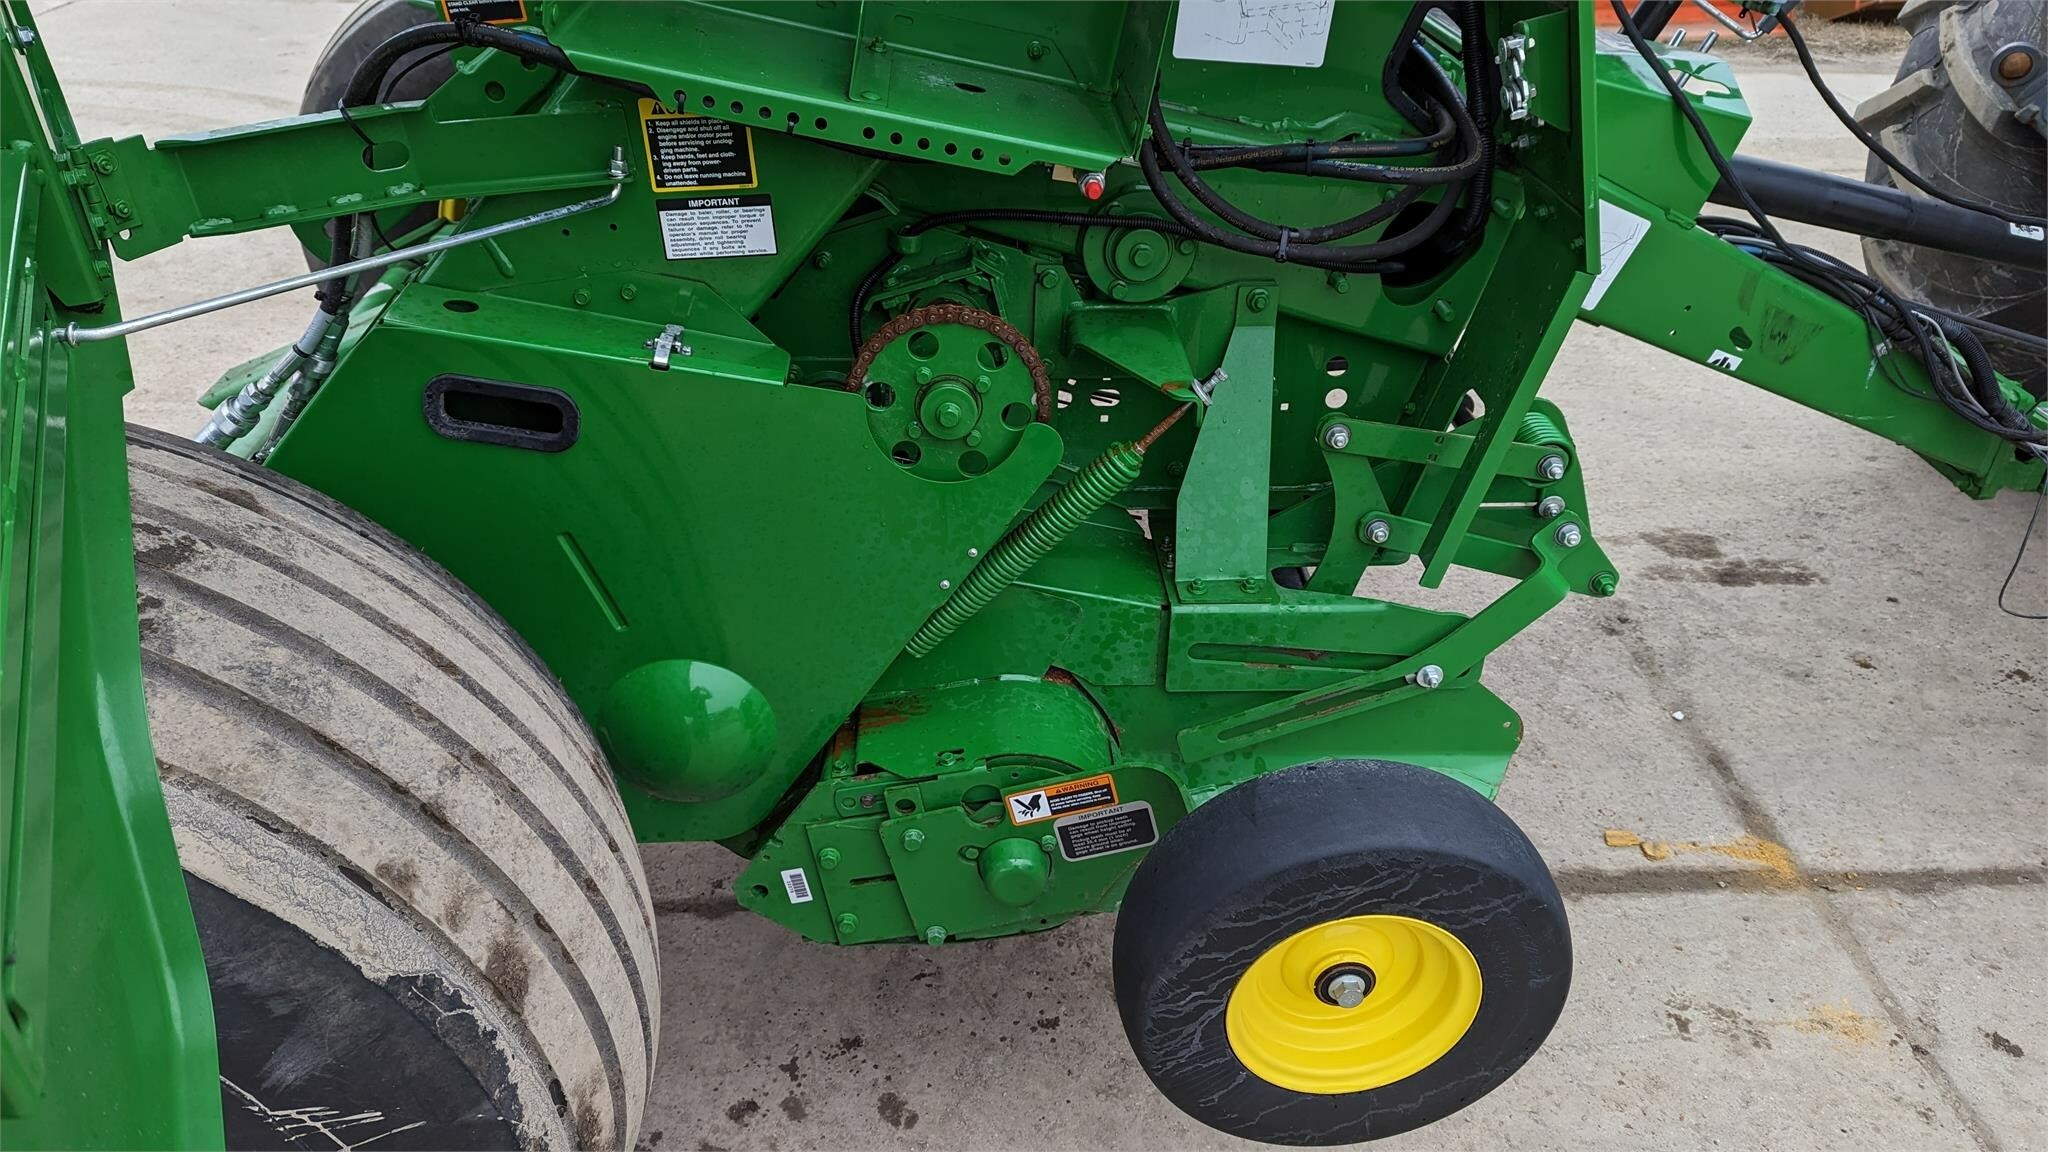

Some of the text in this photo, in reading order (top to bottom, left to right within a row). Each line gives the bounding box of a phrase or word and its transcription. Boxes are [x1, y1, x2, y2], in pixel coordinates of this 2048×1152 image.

[688, 198, 740, 208] IMPORTANT
[1061, 780, 1099, 792] WARNING
[1079, 807, 1124, 820] IMPORTANT
